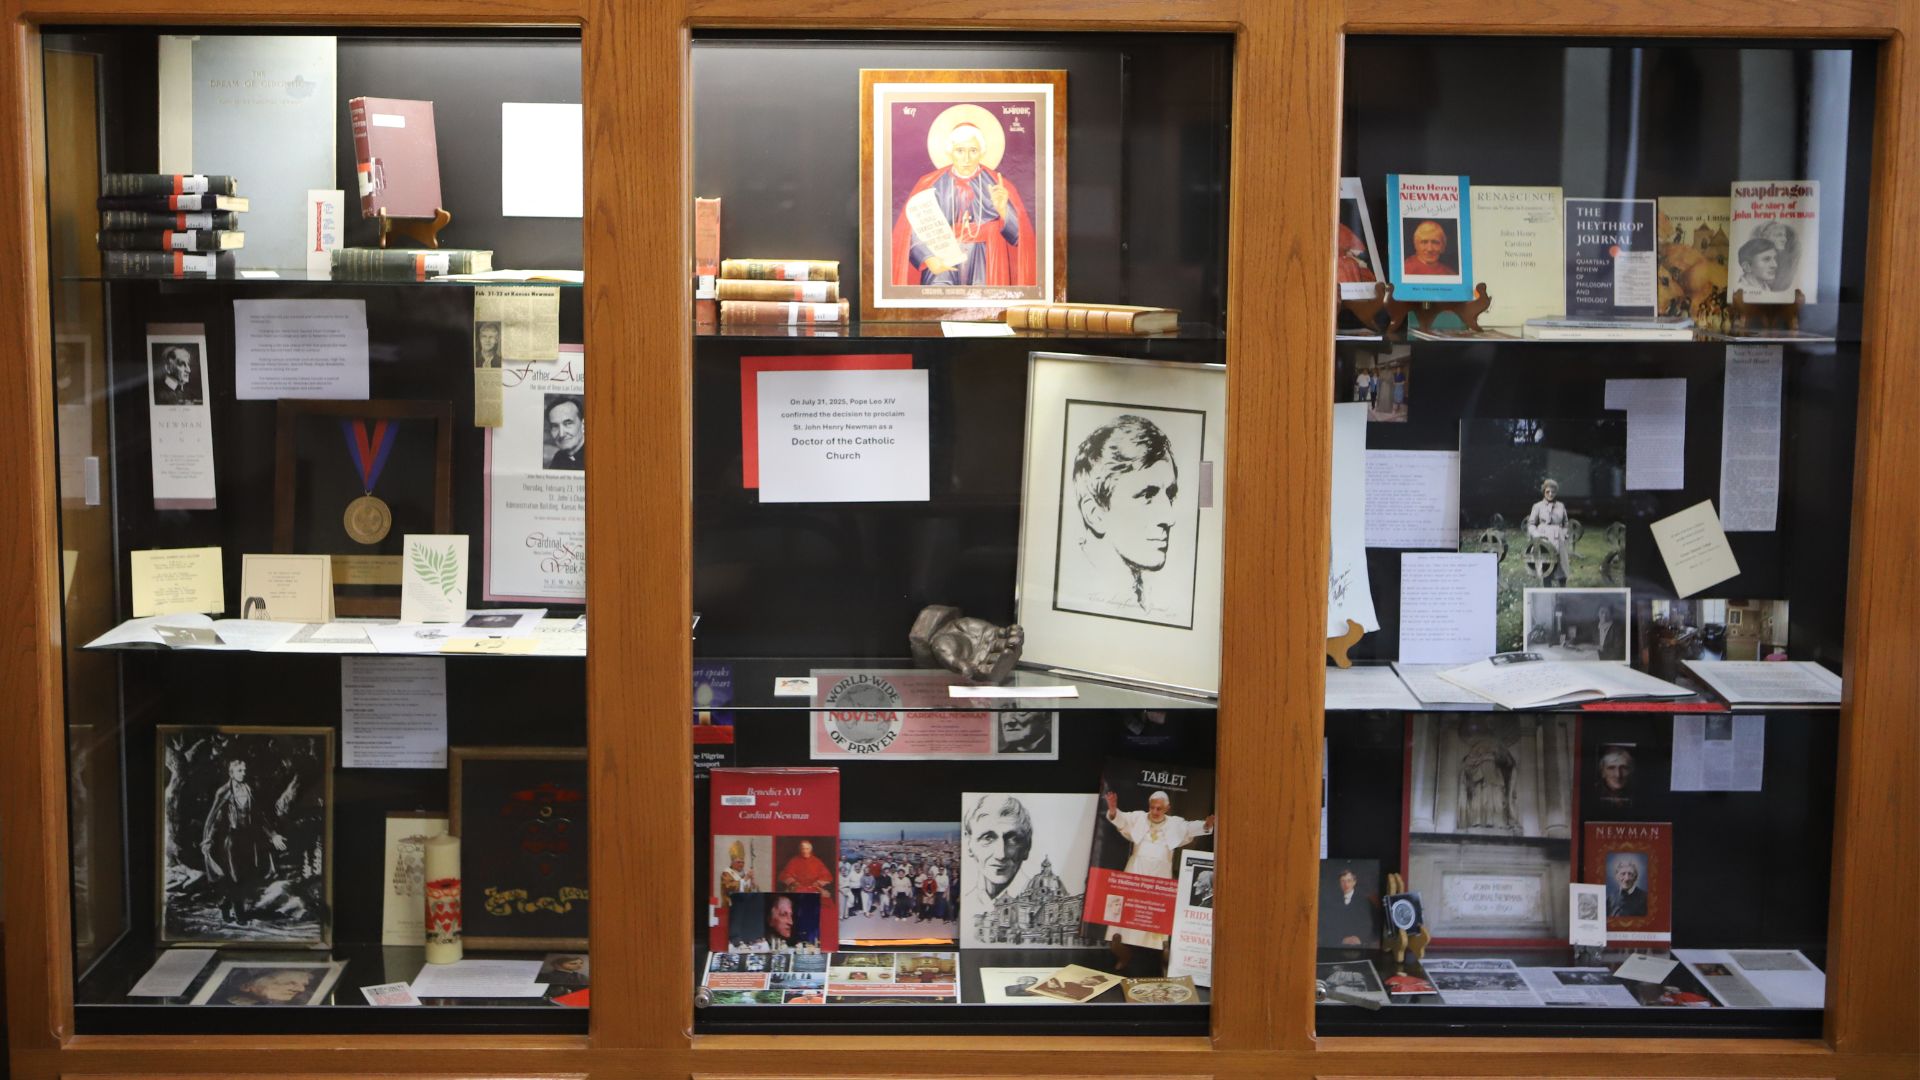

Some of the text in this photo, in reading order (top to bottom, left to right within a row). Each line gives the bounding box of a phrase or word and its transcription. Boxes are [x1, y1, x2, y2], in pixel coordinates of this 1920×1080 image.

[209, 80, 240, 88] DREAM
[1427, 183, 1457, 192] Henry
[1734, 183, 1814, 200] snapdragon
[1399, 192, 1458, 201] NEWMAN
[1477, 192, 1553, 201] RENASCENCE
[1751, 201, 1797, 211] the story of
[1576, 207, 1601, 217] THE
[1732, 210, 1752, 221] john
[1753, 211, 1777, 220] henry
[1576, 221, 1644, 231] HEYTHROP
[1576, 235, 1630, 246] JOURNAL
[502, 360, 550, 387] Father
[802, 398, 816, 408] July
[850, 398, 868, 407] Pope
[873, 411, 905, 419] proclaim
[158, 421, 203, 429] NEWMAN
[822, 424, 844, 433] Henry
[791, 437, 895, 446] Doctor of the Catholic
[826, 451, 861, 460] Church
[525, 532, 562, 548] Cardinal
[540, 558, 578, 574] Week
[705, 666, 729, 680] speaks
[711, 678, 731, 688] heart
[826, 674, 899, 704] WORLD-WIDE
[829, 710, 899, 722] NOVENA
[830, 730, 847, 745] OF
[847, 730, 897, 754] PRAYER
[701, 752, 725, 760] Pilgrim
[1141, 769, 1187, 787] TABLET
[747, 787, 802, 796] Benedict XVI
[738, 811, 809, 820] Cardinal Newman
[1596, 827, 1660, 836] NEWMAN
